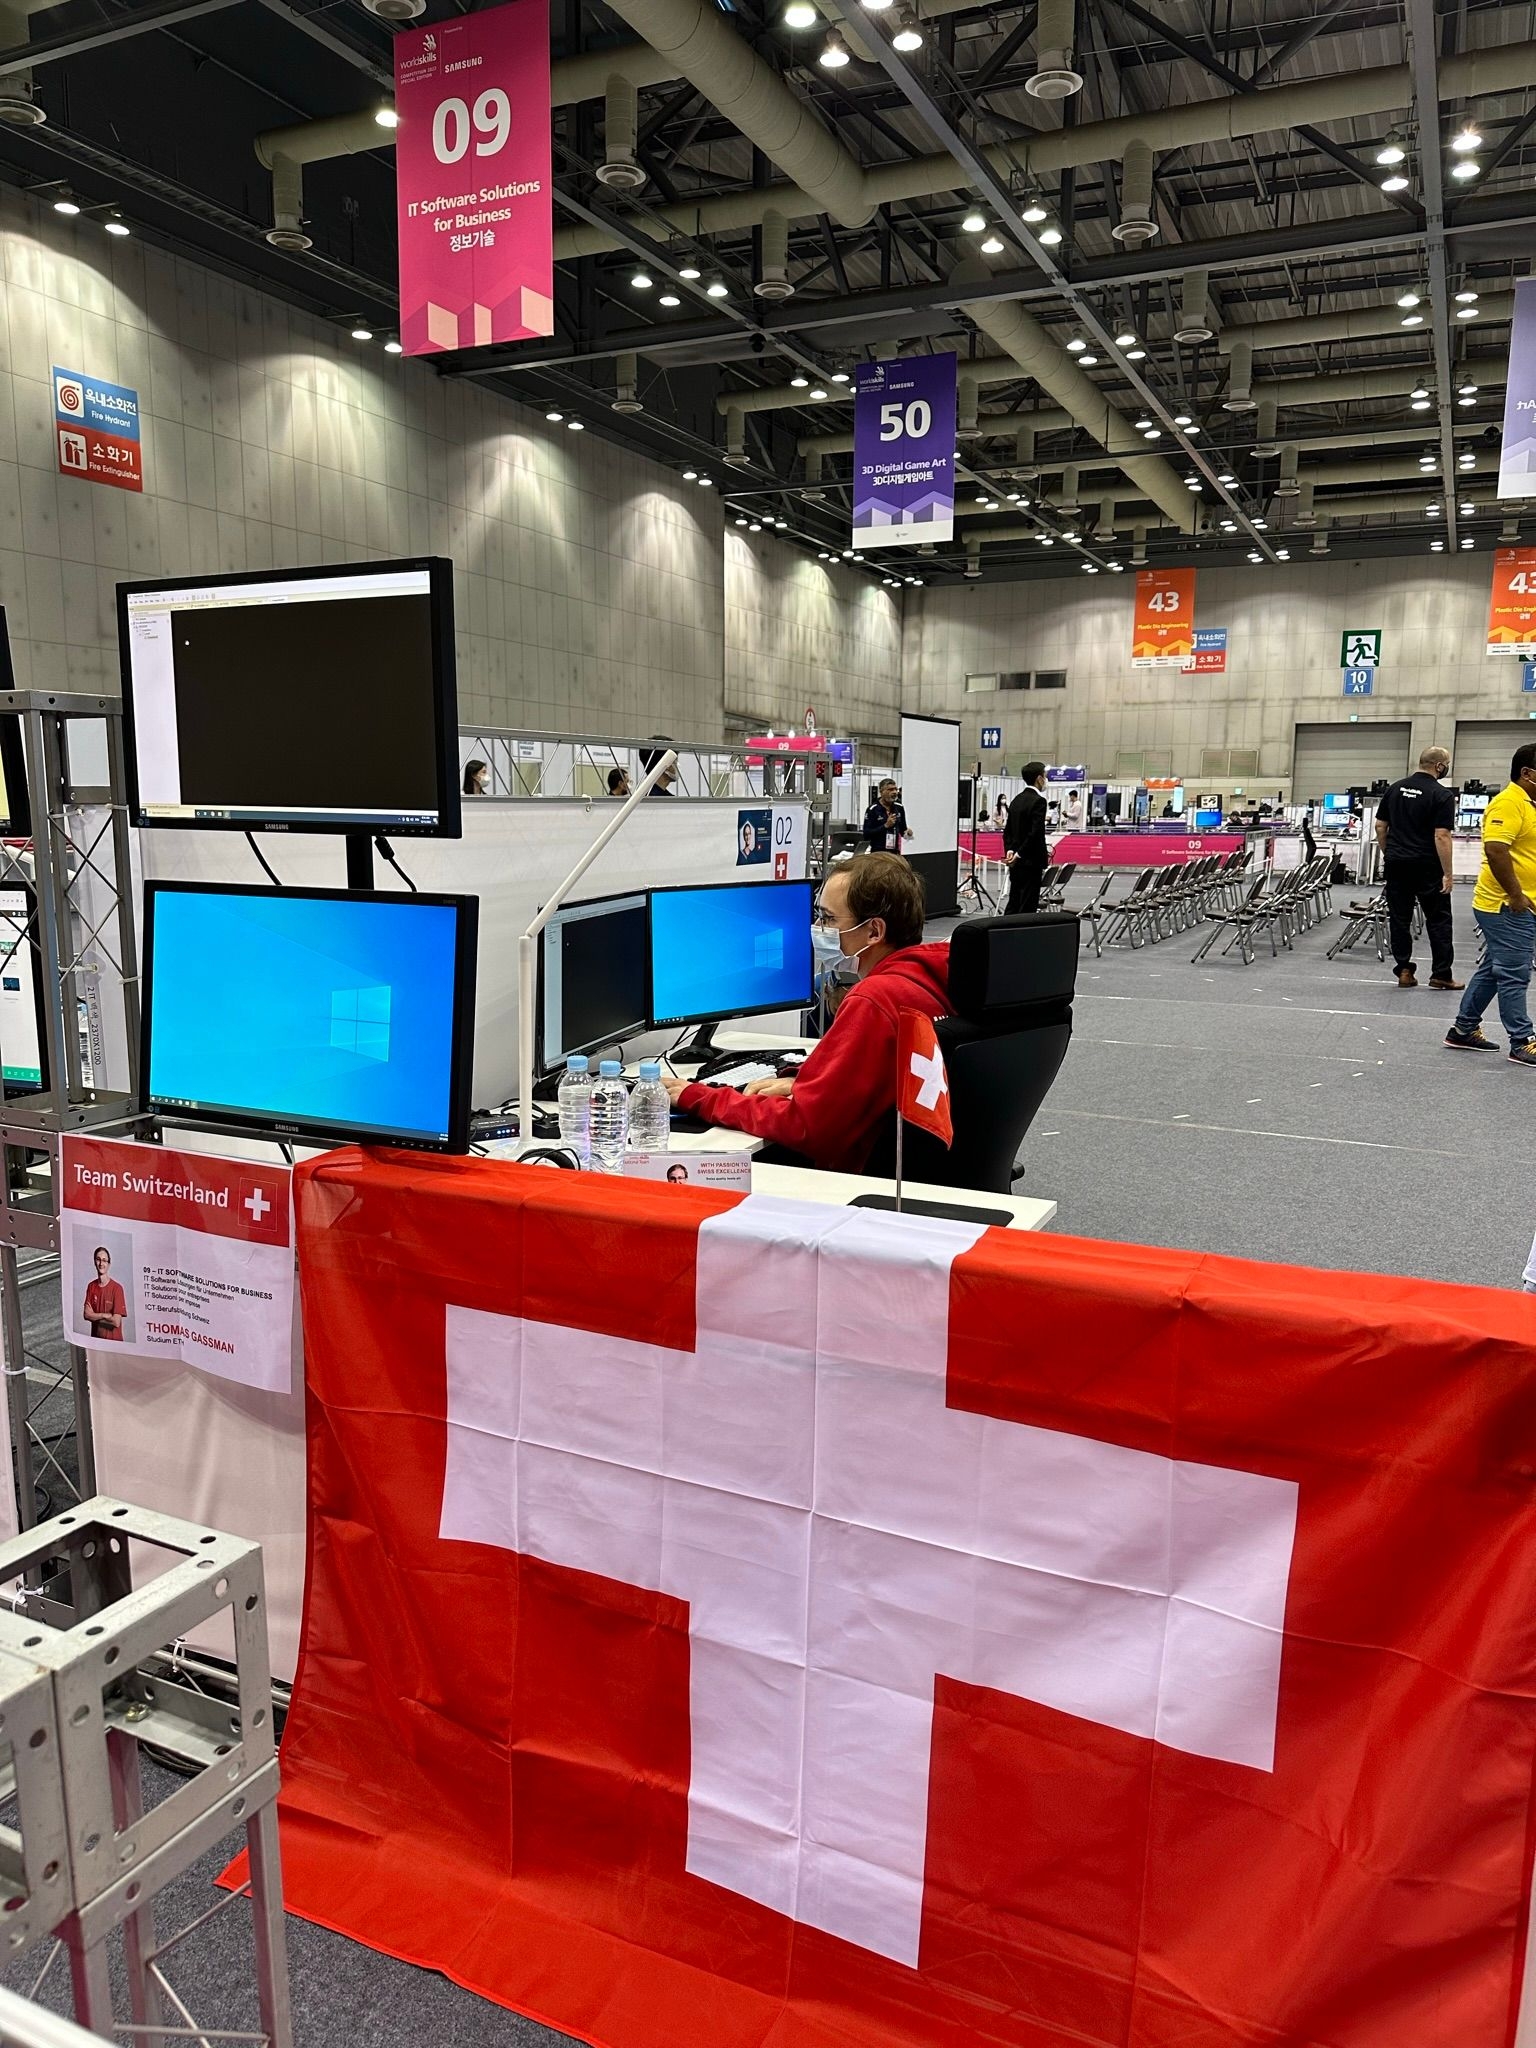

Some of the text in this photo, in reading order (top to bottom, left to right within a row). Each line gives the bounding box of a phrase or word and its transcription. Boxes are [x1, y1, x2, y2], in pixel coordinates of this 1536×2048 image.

[400, 52, 437, 69] worldskills
[445, 56, 482, 73] SAMSUNG
[432, 88, 511, 164] 09
[408, 181, 540, 217] IT Software Solutions
[434, 208, 511, 232] for Business
[449, 229, 495, 252] 정보기술
[890, 382, 914, 390] SAMSUNG
[85, 389, 136, 416] 옥내소화전
[91, 410, 130, 428] Fire Hydrant
[880, 400, 931, 441] 50
[92, 443, 133, 466] 소화기
[89, 462, 140, 480] Fire Extinguisher
[862, 458, 946, 474] 3D Digital Game Art
[1148, 591, 1179, 612] 43
[1350, 671, 1367, 684] 10
[1353, 685, 1364, 693] A1
[778, 742, 789, 750] 09
[776, 816, 793, 845] 02
[1188, 840, 1202, 849] 09
[73, 1164, 229, 1208] Team Switzerland
[150, 1275, 176, 1284] Software
[151, 1284, 177, 1292] Solutions
[195, 1276, 226, 1290] SOLUTIONS
[227, 1285, 240, 1294] FOR
[241, 1288, 273, 1300] BUSINESS
[151, 1292, 177, 1301] Soluzioni
[146, 1322, 234, 1354] THOMAS GASSMAN
[147, 1335, 171, 1344] Studium
